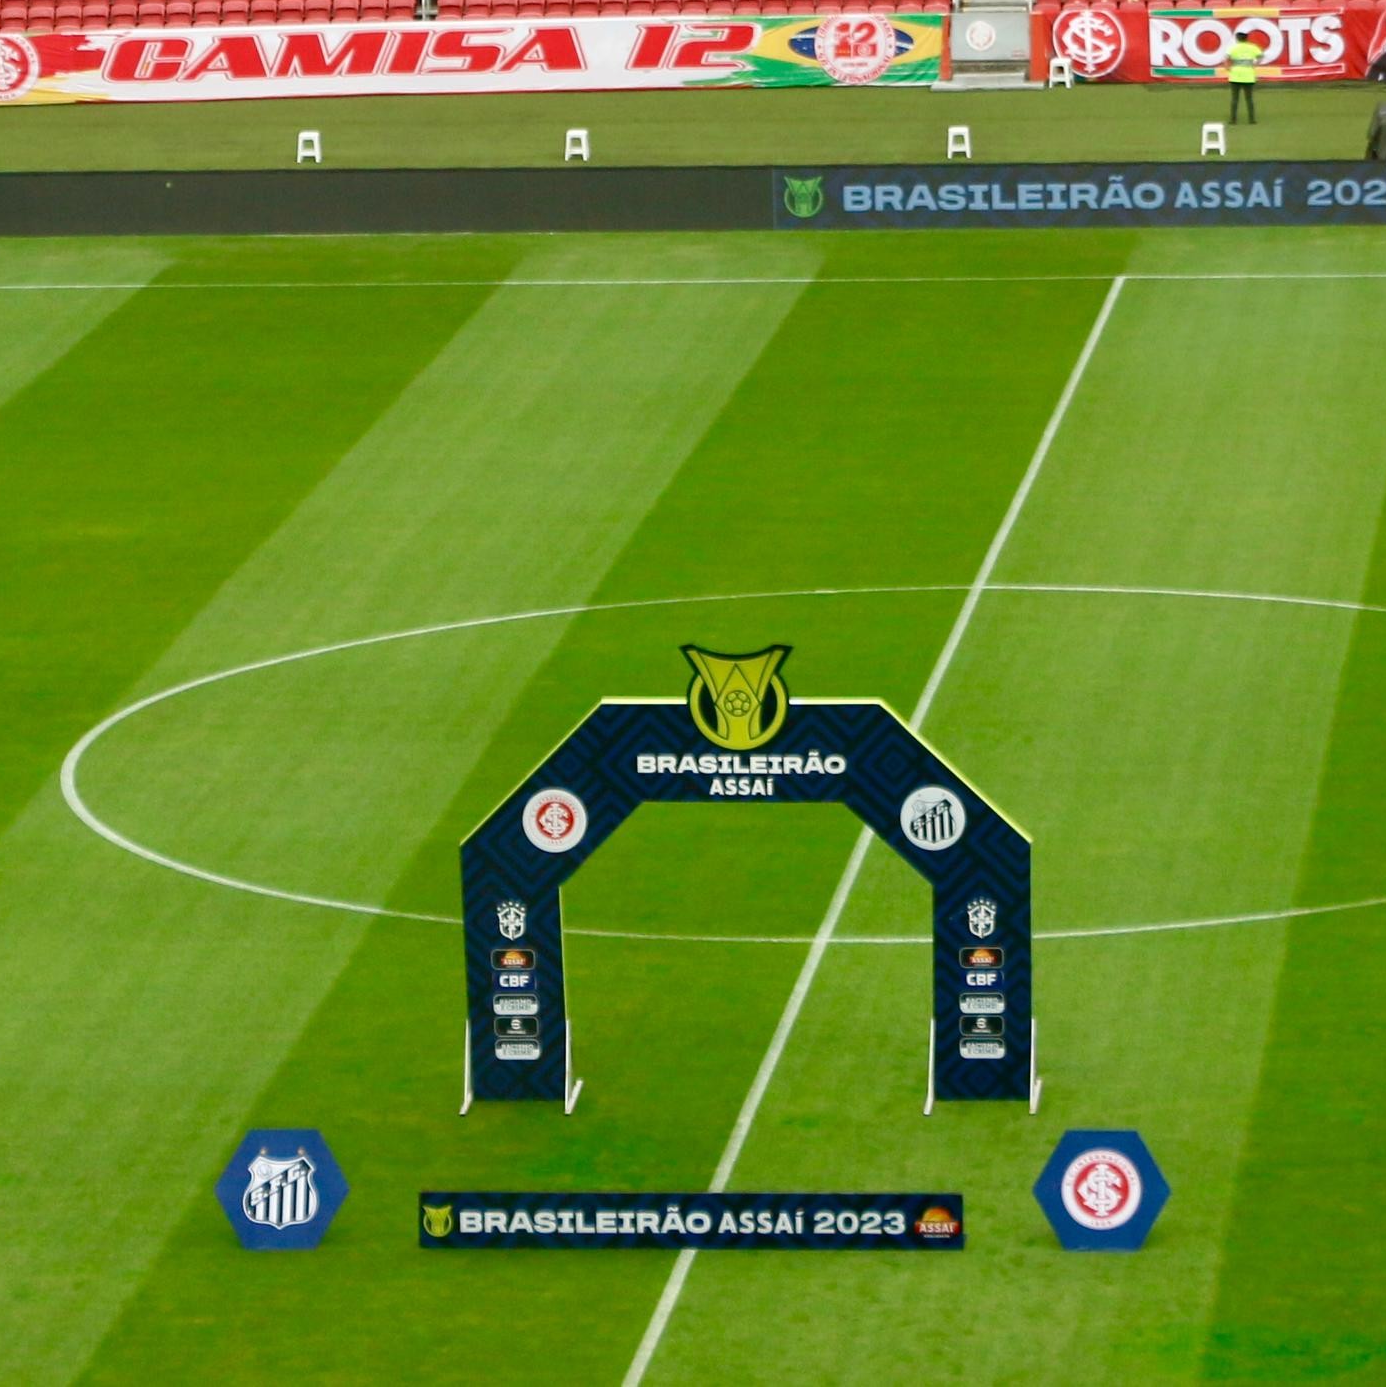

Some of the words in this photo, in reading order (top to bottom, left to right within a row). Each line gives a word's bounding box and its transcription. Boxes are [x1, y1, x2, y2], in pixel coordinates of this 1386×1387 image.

[101, 24, 589, 82] CAMISA
[625, 21, 763, 71] 12
[1149, 15, 1346, 69] ROOTS
[842, 175, 1165, 212] BRASILEIRÃO
[636, 750, 846, 775] BRASILEIRÃO
[499, 975, 530, 988] CBF
[966, 973, 997, 986] CBF
[459, 1206, 711, 1235] BRASILEIRÃO
[813, 1211, 907, 1235] 2023
